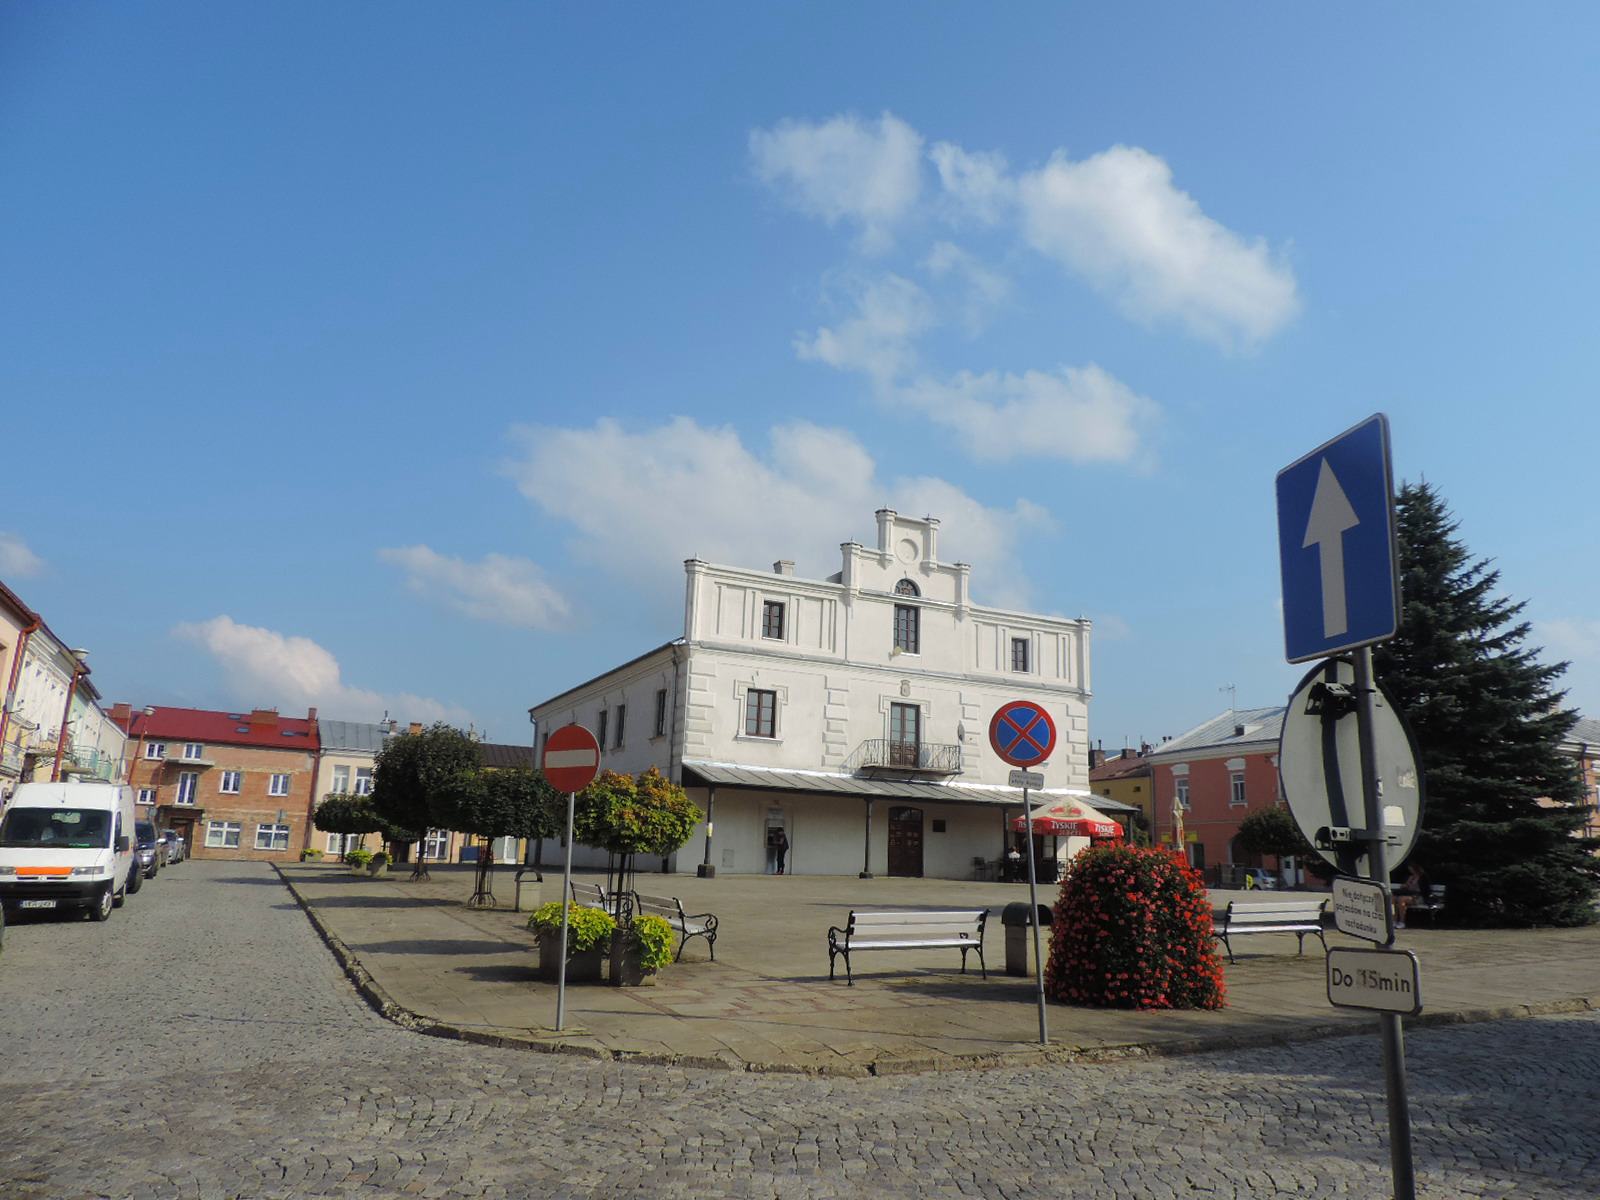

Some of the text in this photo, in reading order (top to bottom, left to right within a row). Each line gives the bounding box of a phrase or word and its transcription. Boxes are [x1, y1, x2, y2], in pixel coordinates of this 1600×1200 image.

[1051, 820, 1078, 831] TYSKIE
[1094, 823, 1115, 833] TYSKIE
[1332, 967, 1353, 987] Do
